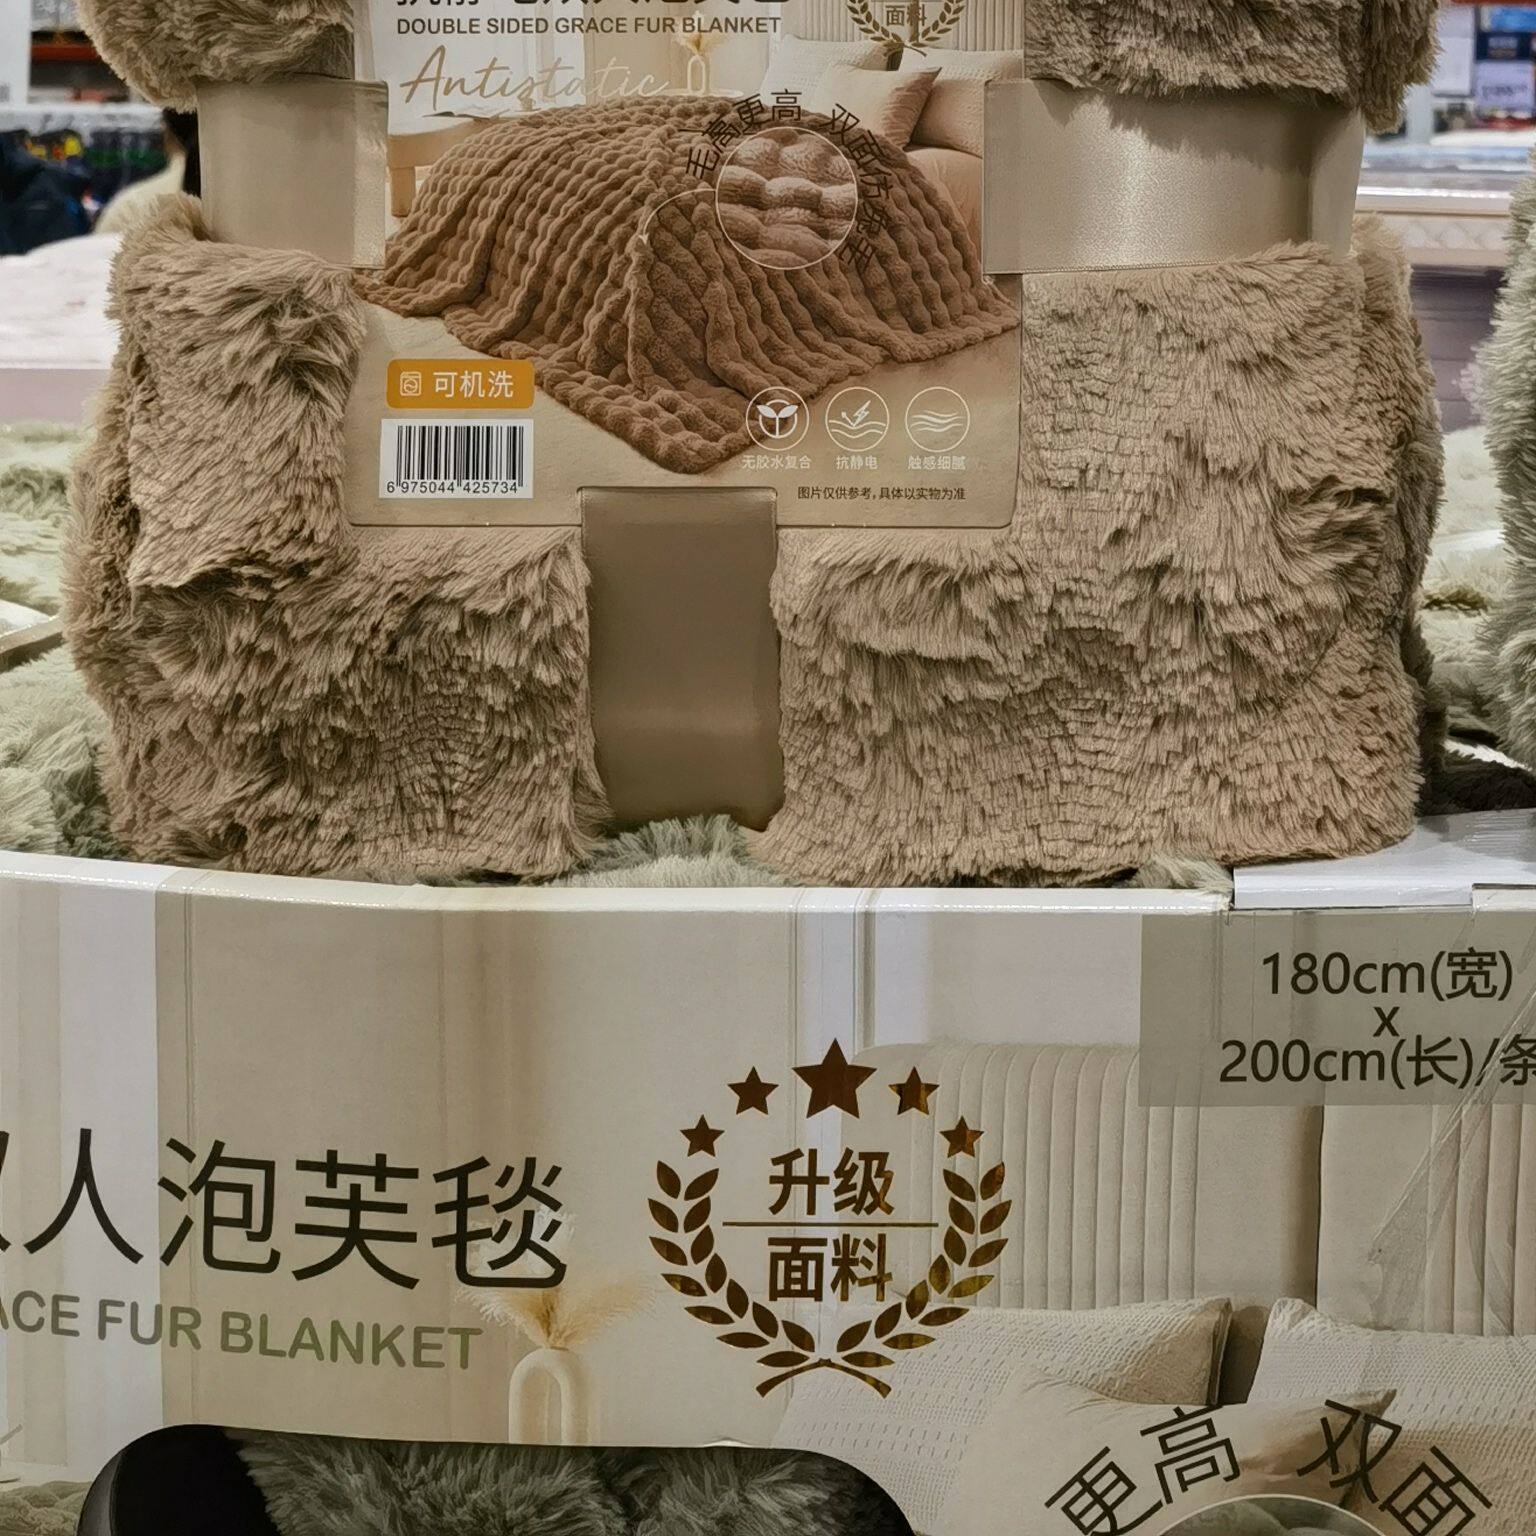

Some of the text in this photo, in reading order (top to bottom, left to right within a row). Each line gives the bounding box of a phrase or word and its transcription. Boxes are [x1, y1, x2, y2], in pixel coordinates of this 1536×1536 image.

[397, 16, 782, 35] DOUBLE SIDED GRACE FUR BLANKET
[885, 4, 927, 28] 面料
[400, 44, 671, 105] Antistatic
[433, 370, 514, 398] 可机洗
[742, 455, 967, 470] 无胶水复合 抗静电 触感细腻
[1260, 947, 1514, 1001] 180cm(宽)
[0, 1128, 567, 1291] 人泡芙毯
[768, 1148, 892, 1216] 升级
[768, 1234, 892, 1302] 面料
[98, 1300, 201, 1350] FUR
[219, 1312, 483, 1369] BLANKET
[1044, 1399, 1493, 1536] 更高 双面
